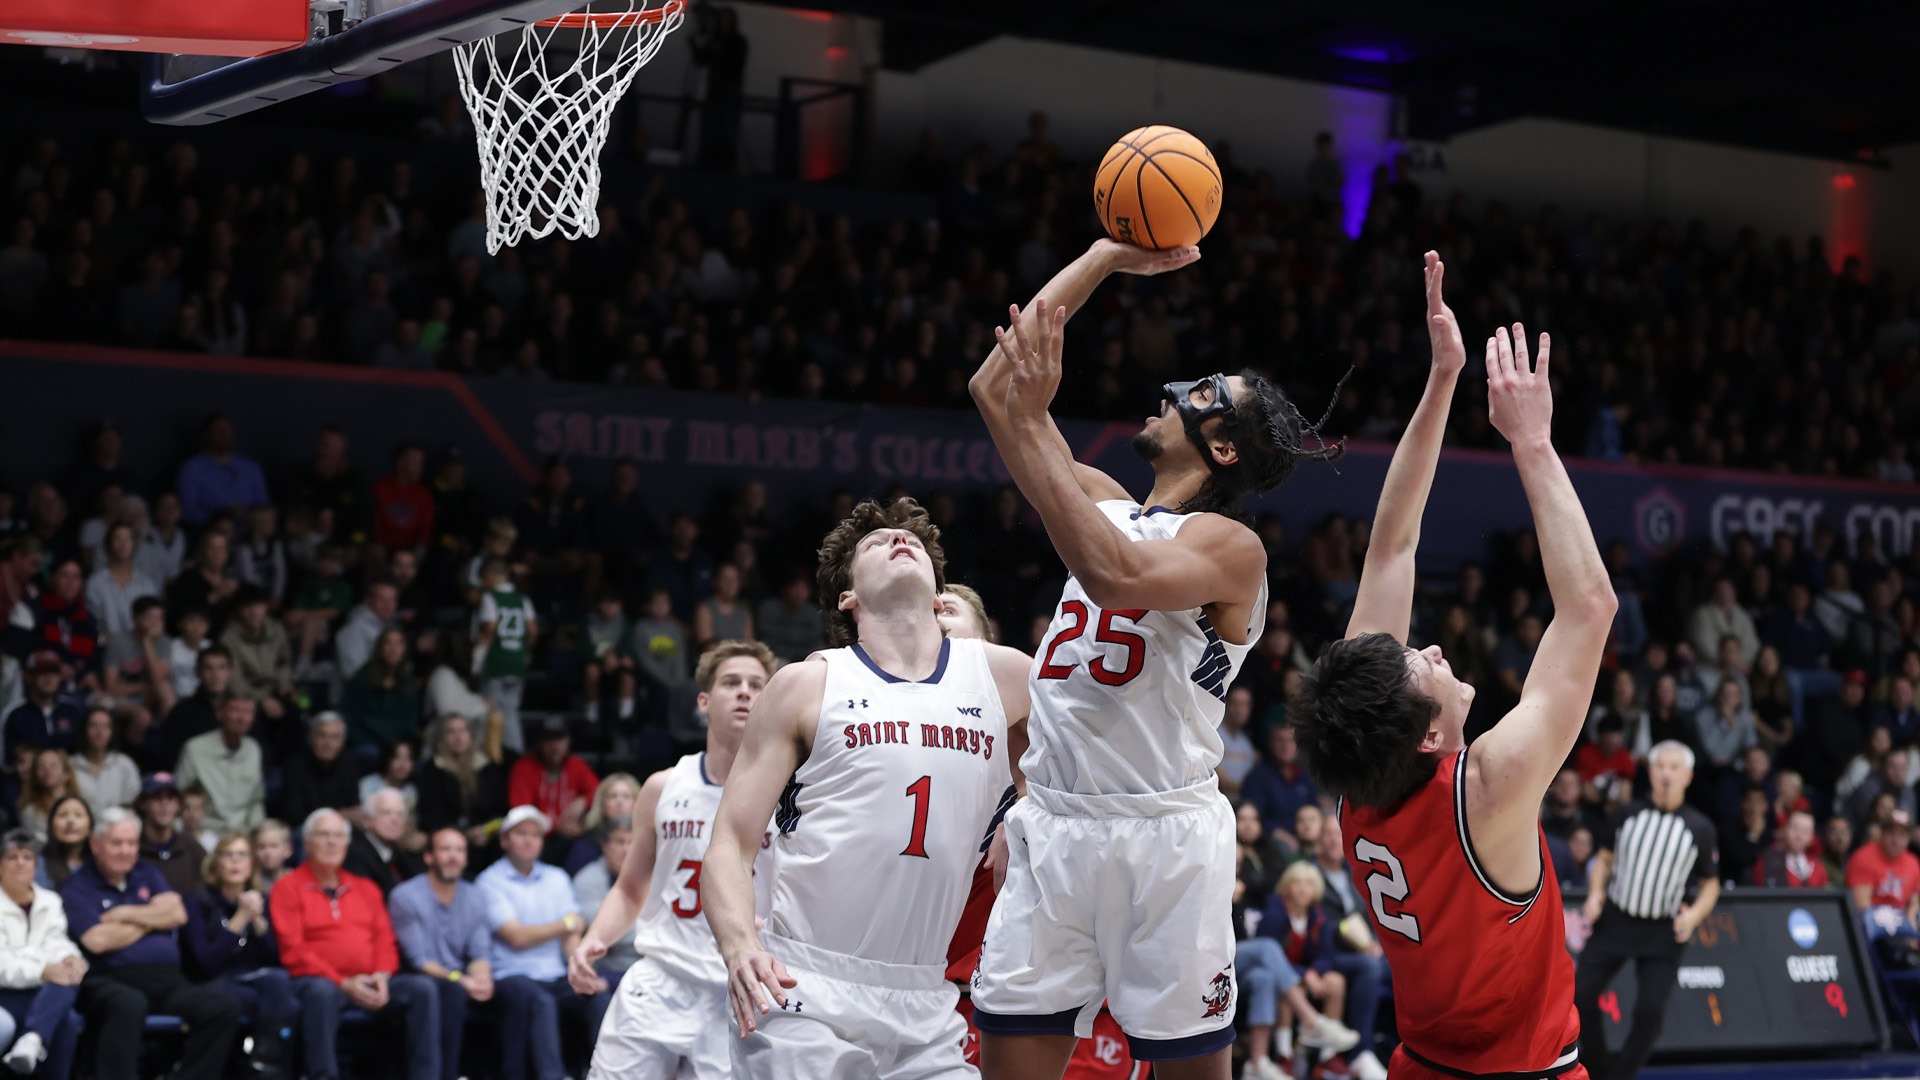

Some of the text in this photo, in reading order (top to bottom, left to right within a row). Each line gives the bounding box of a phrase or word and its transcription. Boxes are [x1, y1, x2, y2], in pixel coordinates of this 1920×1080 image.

[534, 410, 673, 462] SAINT
[686, 420, 859, 473] MARY'S
[1037, 599, 1150, 687] 25
[956, 706, 982, 719] WCC
[843, 721, 995, 760] SAINT MARY'S
[661, 820, 705, 840] SAINT
[899, 775, 931, 860] 1
[672, 859, 703, 919] 3
[1354, 834, 1422, 945] 2
[1786, 954, 1839, 983] GUEST
[1825, 982, 1848, 1019] 9
[1095, 1035, 1123, 1065] DC
